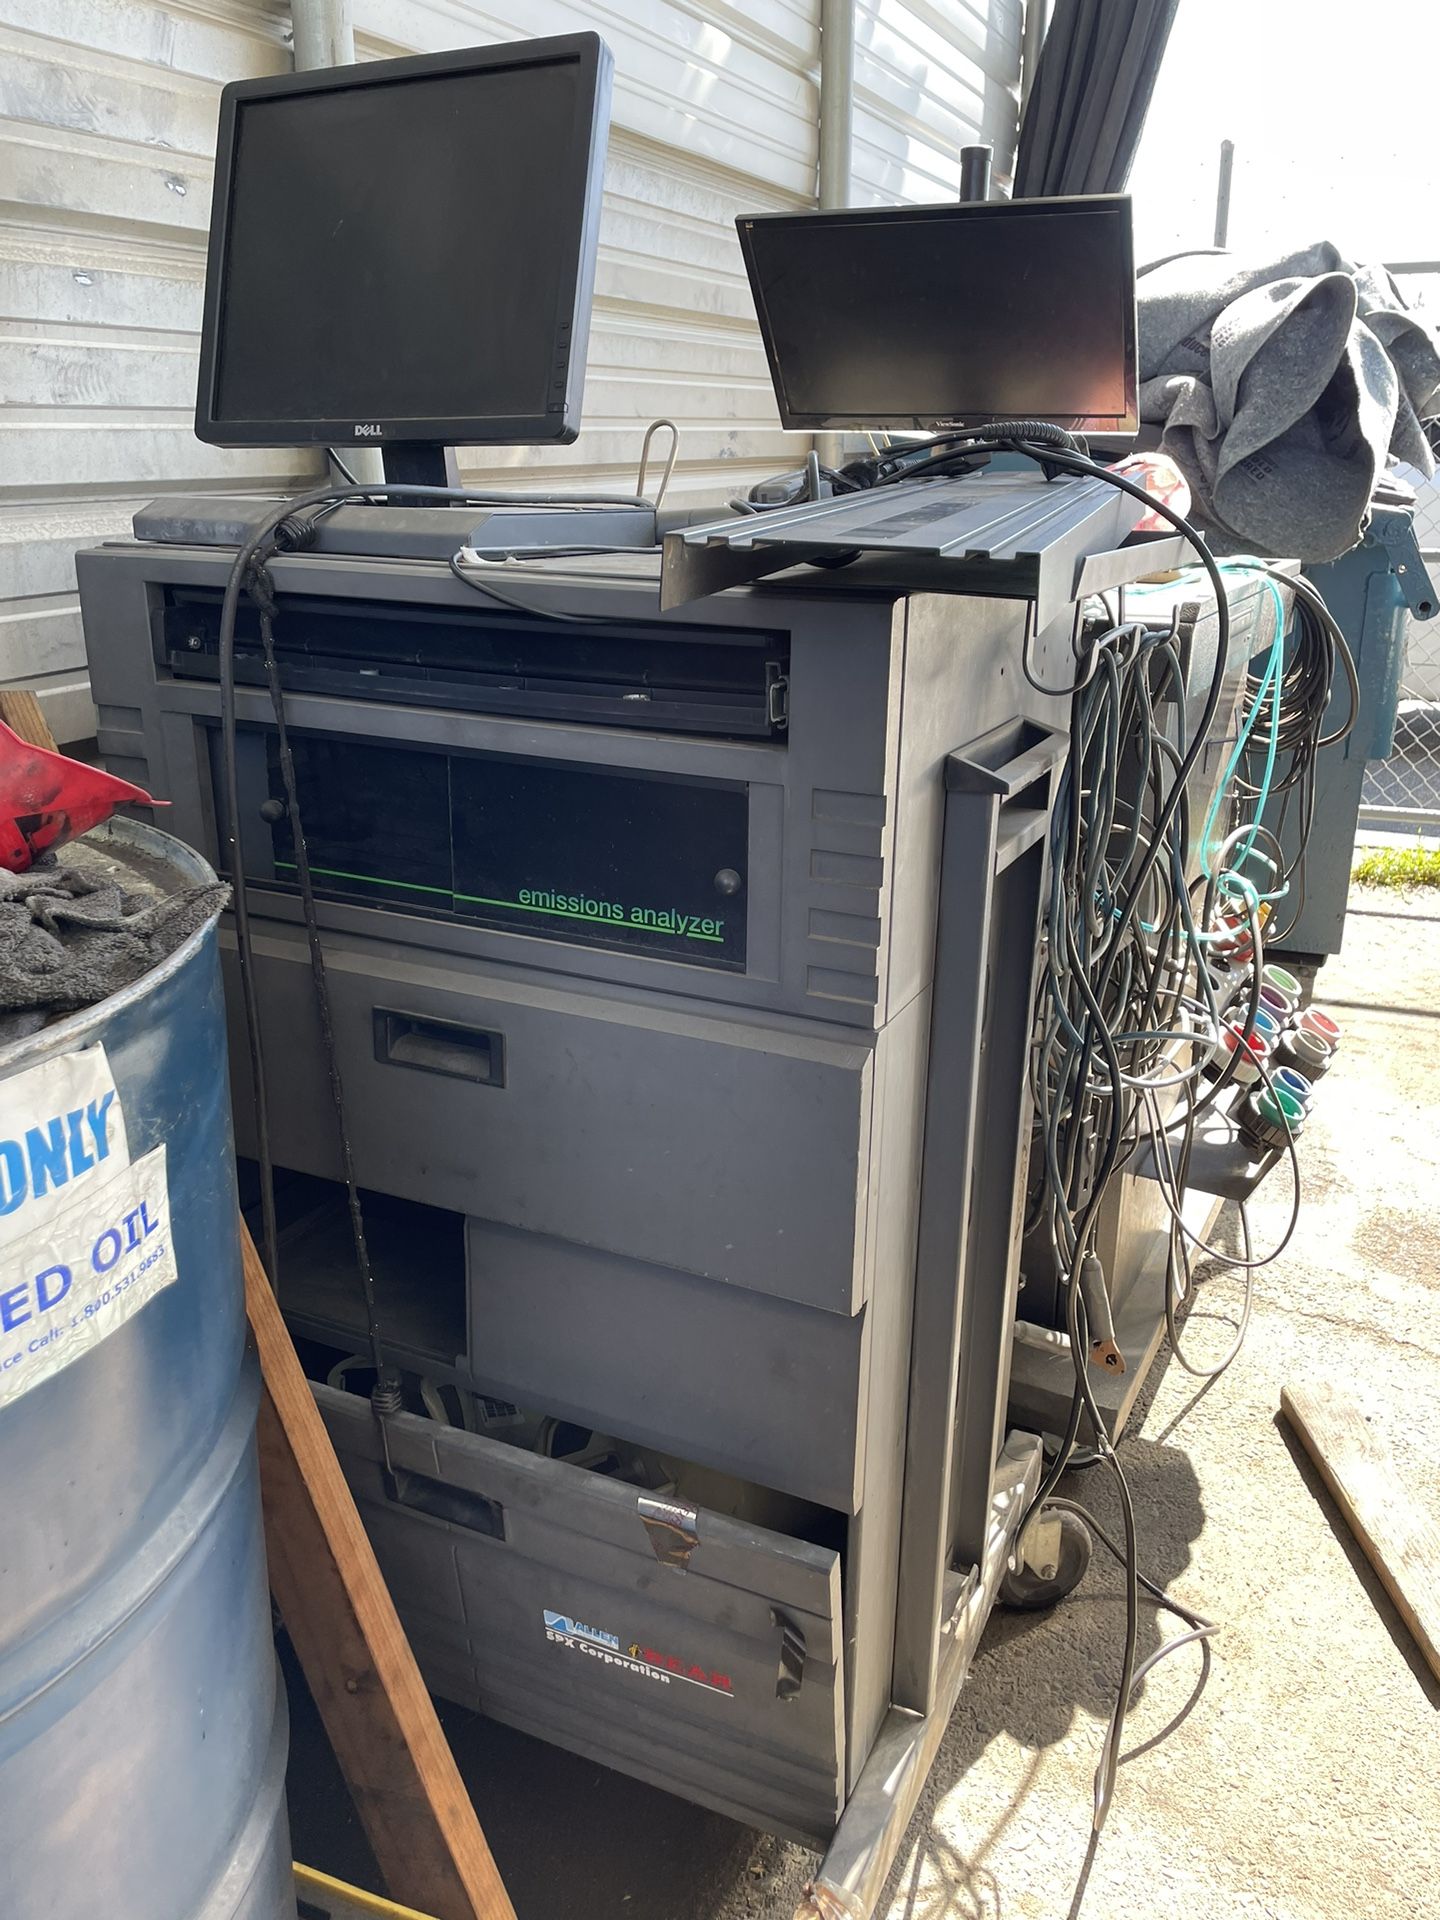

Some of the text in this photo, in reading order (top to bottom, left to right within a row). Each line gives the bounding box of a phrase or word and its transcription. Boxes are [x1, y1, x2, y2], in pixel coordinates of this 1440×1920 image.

[354, 424, 383, 436] DELL
[518, 889, 725, 935] emissions analyzer
[91, 1200, 160, 1273] OIL
[546, 1631, 670, 1684] SPX Corporation
[574, 1621, 732, 1688] ALLEN BEAR
